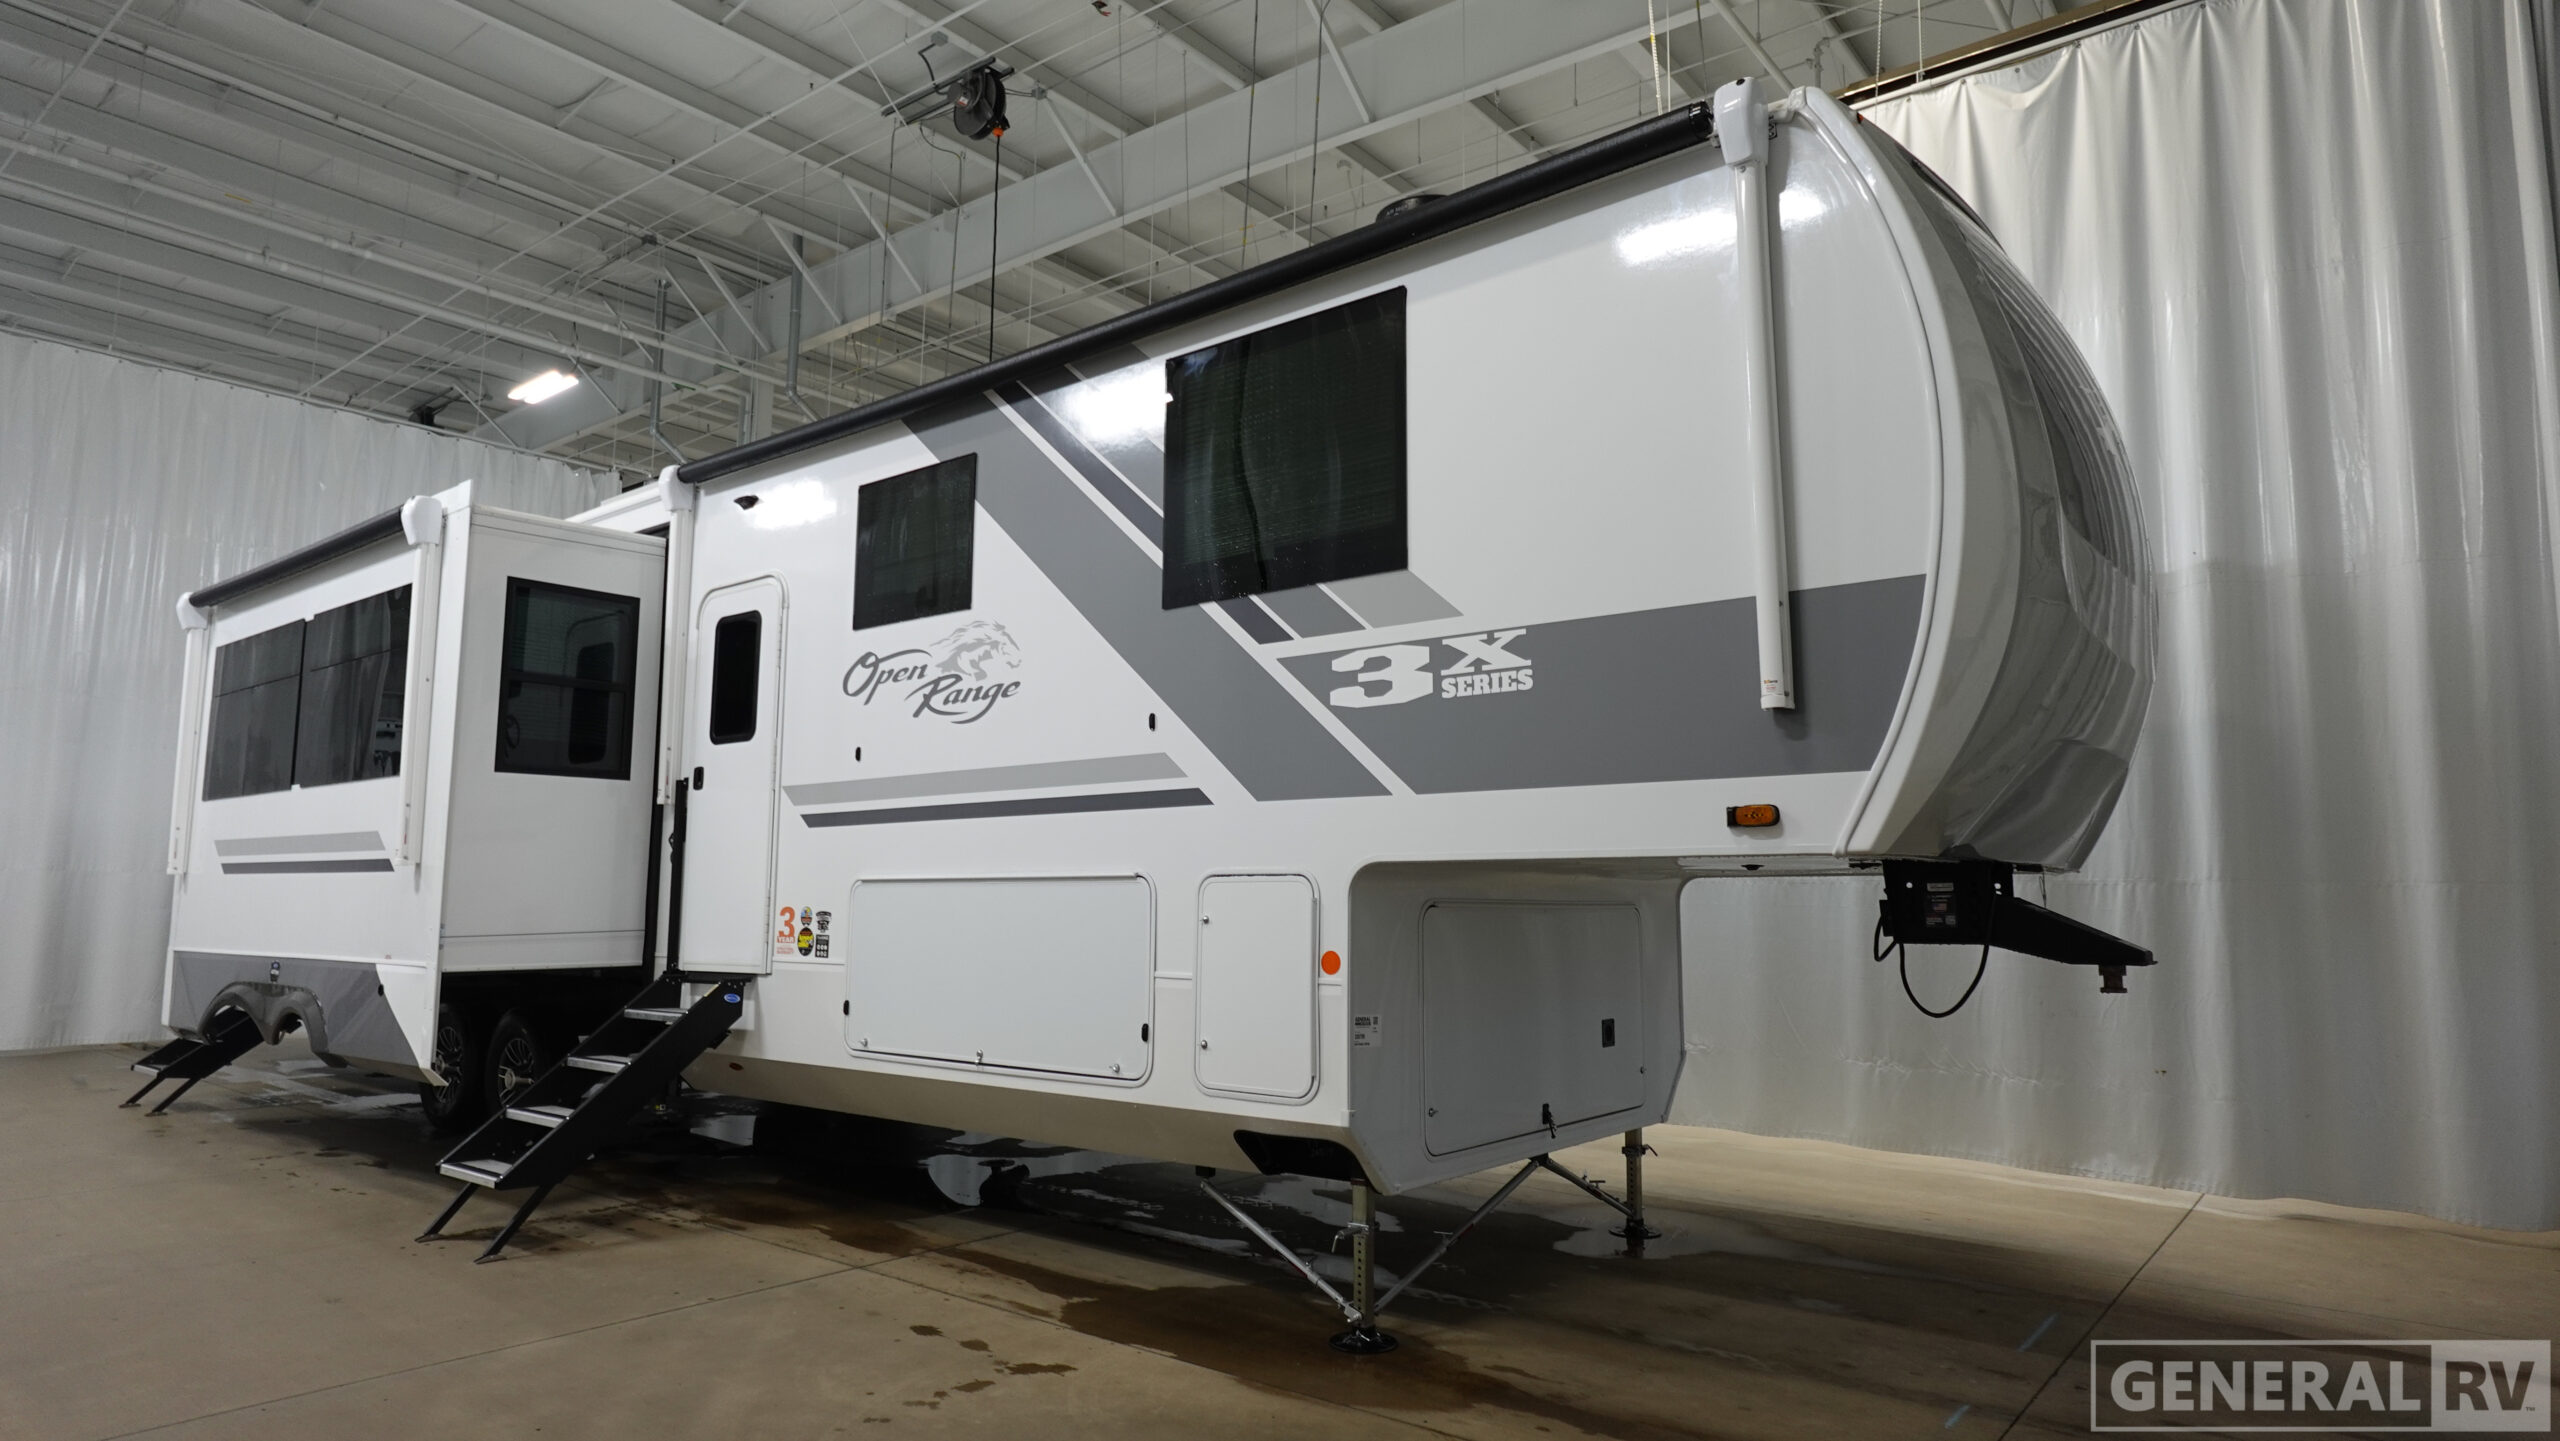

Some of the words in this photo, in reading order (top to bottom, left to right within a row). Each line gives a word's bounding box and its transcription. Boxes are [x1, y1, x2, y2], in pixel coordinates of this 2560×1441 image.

[843, 649, 933, 706] Open
[904, 673, 1021, 724] Range
[1441, 668, 1533, 699] SERIES
[778, 906, 796, 937] 3
